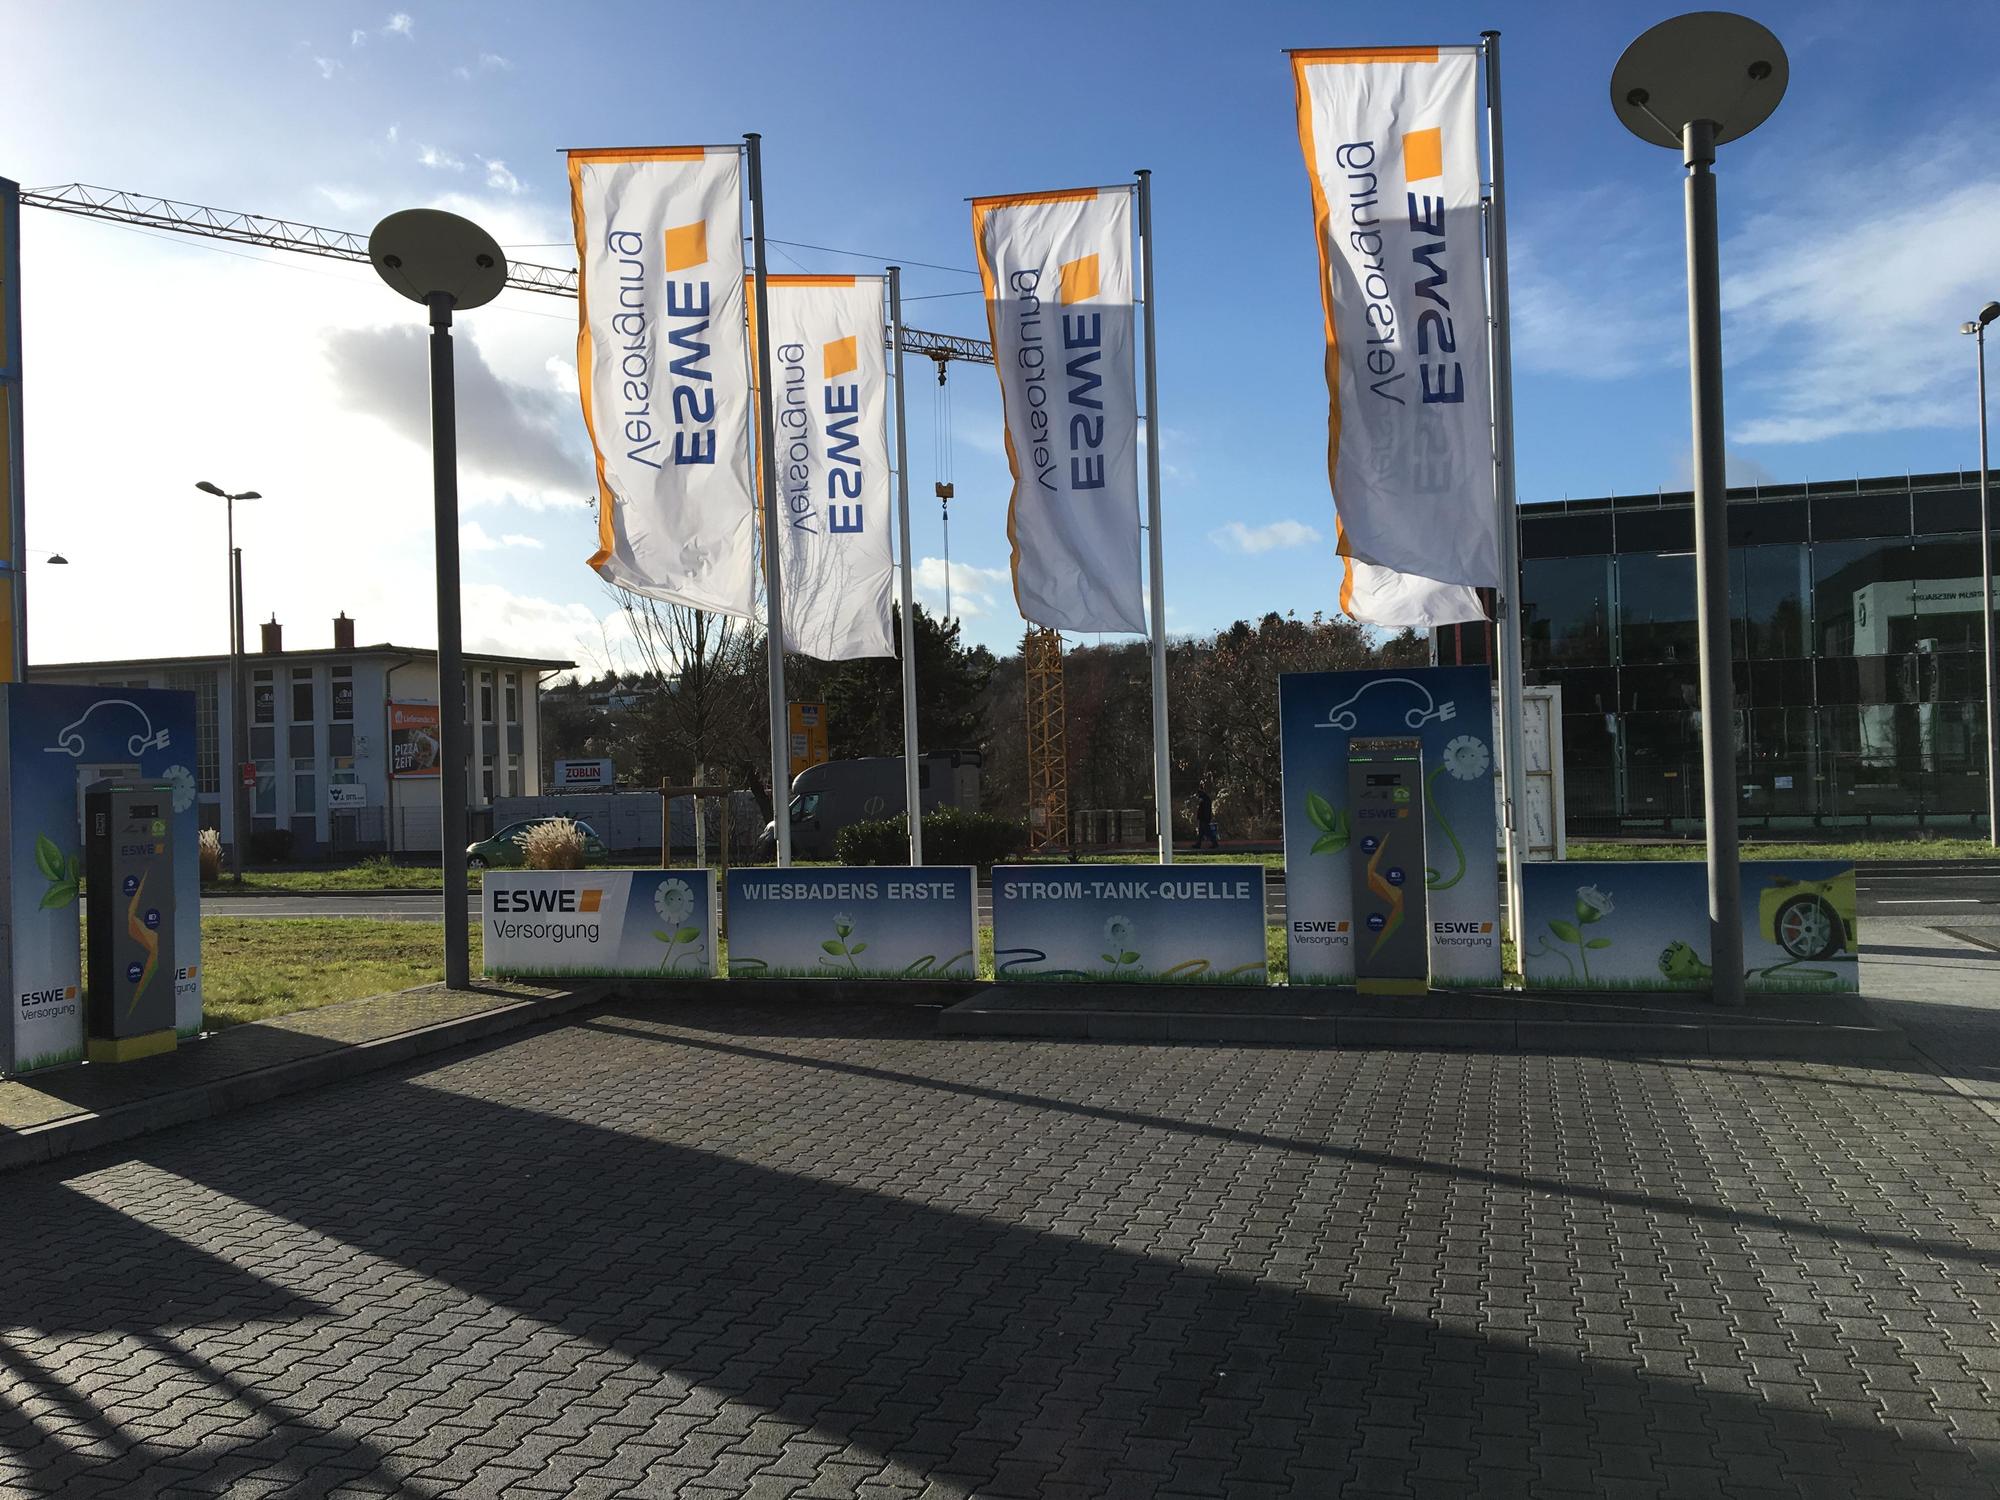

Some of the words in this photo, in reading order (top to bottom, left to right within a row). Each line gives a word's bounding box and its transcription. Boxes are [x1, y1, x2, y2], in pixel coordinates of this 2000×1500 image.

[394, 743, 419, 756] PIZZA
[394, 756, 413, 770] ZEIT
[1358, 808, 1397, 819] ESWE
[121, 843, 155, 857] ESWE
[742, 882, 879, 901] WIESBADENS
[887, 882, 956, 900] ERSTE
[1004, 881, 1251, 901] STROM-TANK-QUELLE
[493, 889, 576, 913] ESWE
[493, 919, 599, 944] Versorgung
[1294, 921, 1337, 933] ESWE
[1434, 922, 1479, 934] ESWE
[1294, 933, 1349, 947] Versorgung
[1434, 934, 1492, 948] Versorgung
[21, 988, 64, 1008] ESWE
[21, 1003, 76, 1022] Versorgung
